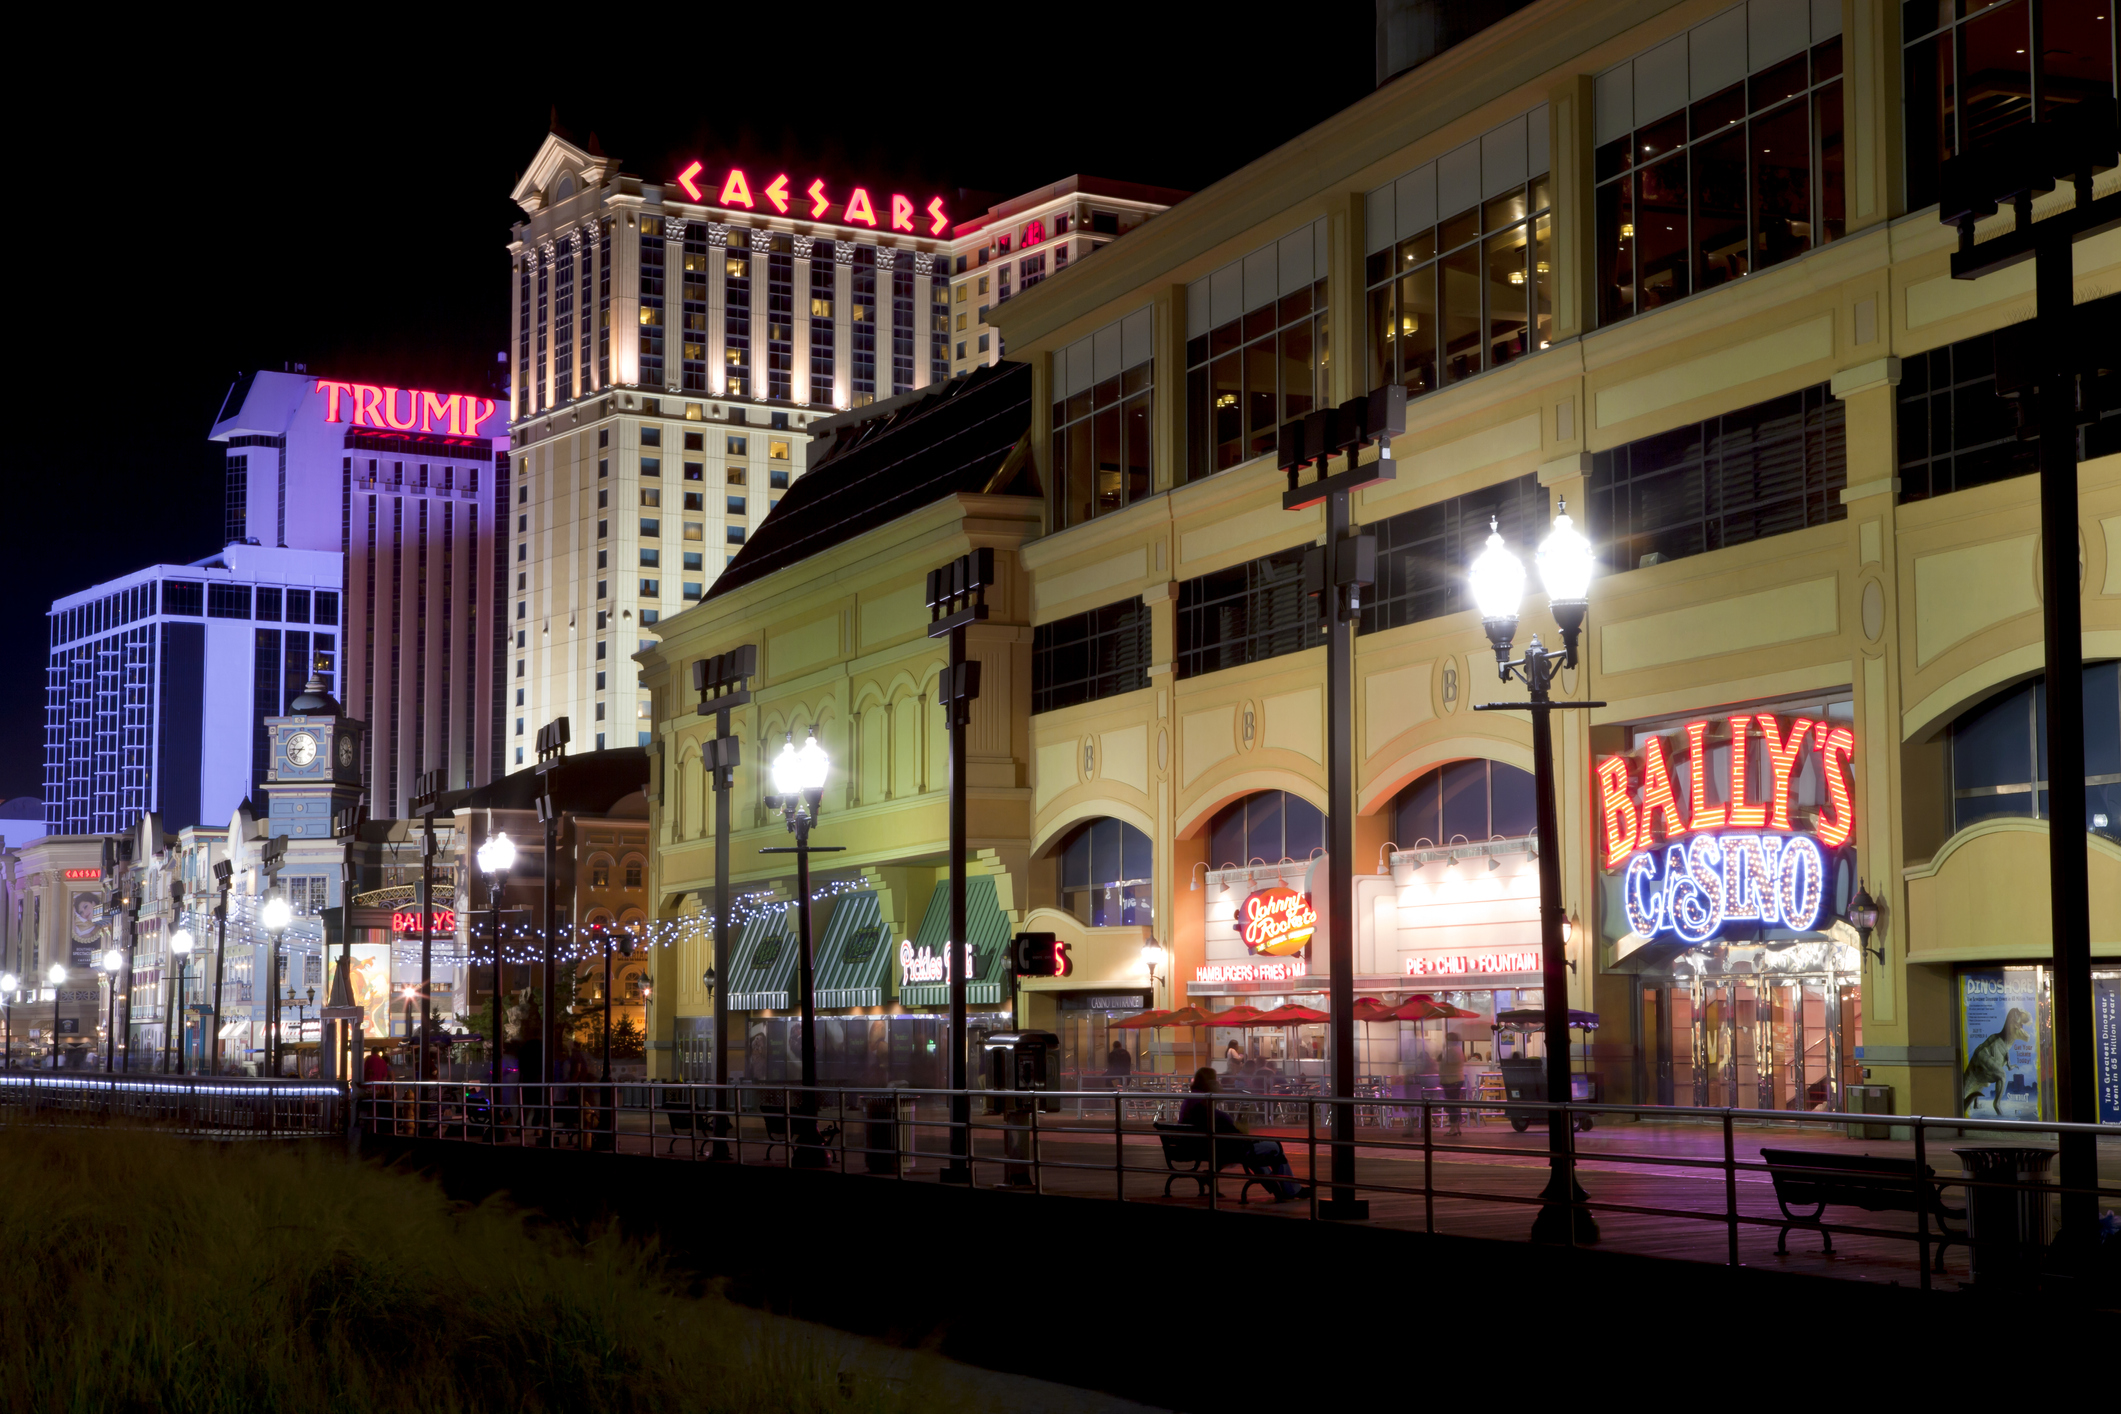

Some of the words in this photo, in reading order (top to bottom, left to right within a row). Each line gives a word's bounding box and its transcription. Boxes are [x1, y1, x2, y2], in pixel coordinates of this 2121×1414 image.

[678, 161, 949, 236] CAESARS
[315, 380, 496, 437] TRUMP
[1594, 713, 1856, 869] BALLY'S
[65, 869, 100, 879] CAESA
[1625, 834, 1823, 942] CASINO
[392, 911, 456, 932] BALY'S
[1246, 892, 1306, 942] Johnny
[1255, 910, 1318, 943] Rockets
[900, 939, 943, 986] Pickles
[943, 940, 974, 985] Dli
[1196, 964, 1254, 982] HAMBURGERS
[1260, 963, 1286, 980] FRIES
[1406, 957, 1426, 975] PIE
[1436, 956, 1467, 975] CHILI
[1479, 952, 1539, 973] FOUNTAIN
[1967, 978, 2034, 994] DINOSHORE
[1091, 997, 1111, 1009] CASINO
[1112, 995, 1140, 1008] ENTRANCE
[2103, 1042, 2111, 1084] Greatest
[2111, 1058, 2118, 1070] 65
[2112, 1072, 2118, 1082] in
[2112, 1084, 2120, 1111] Event
